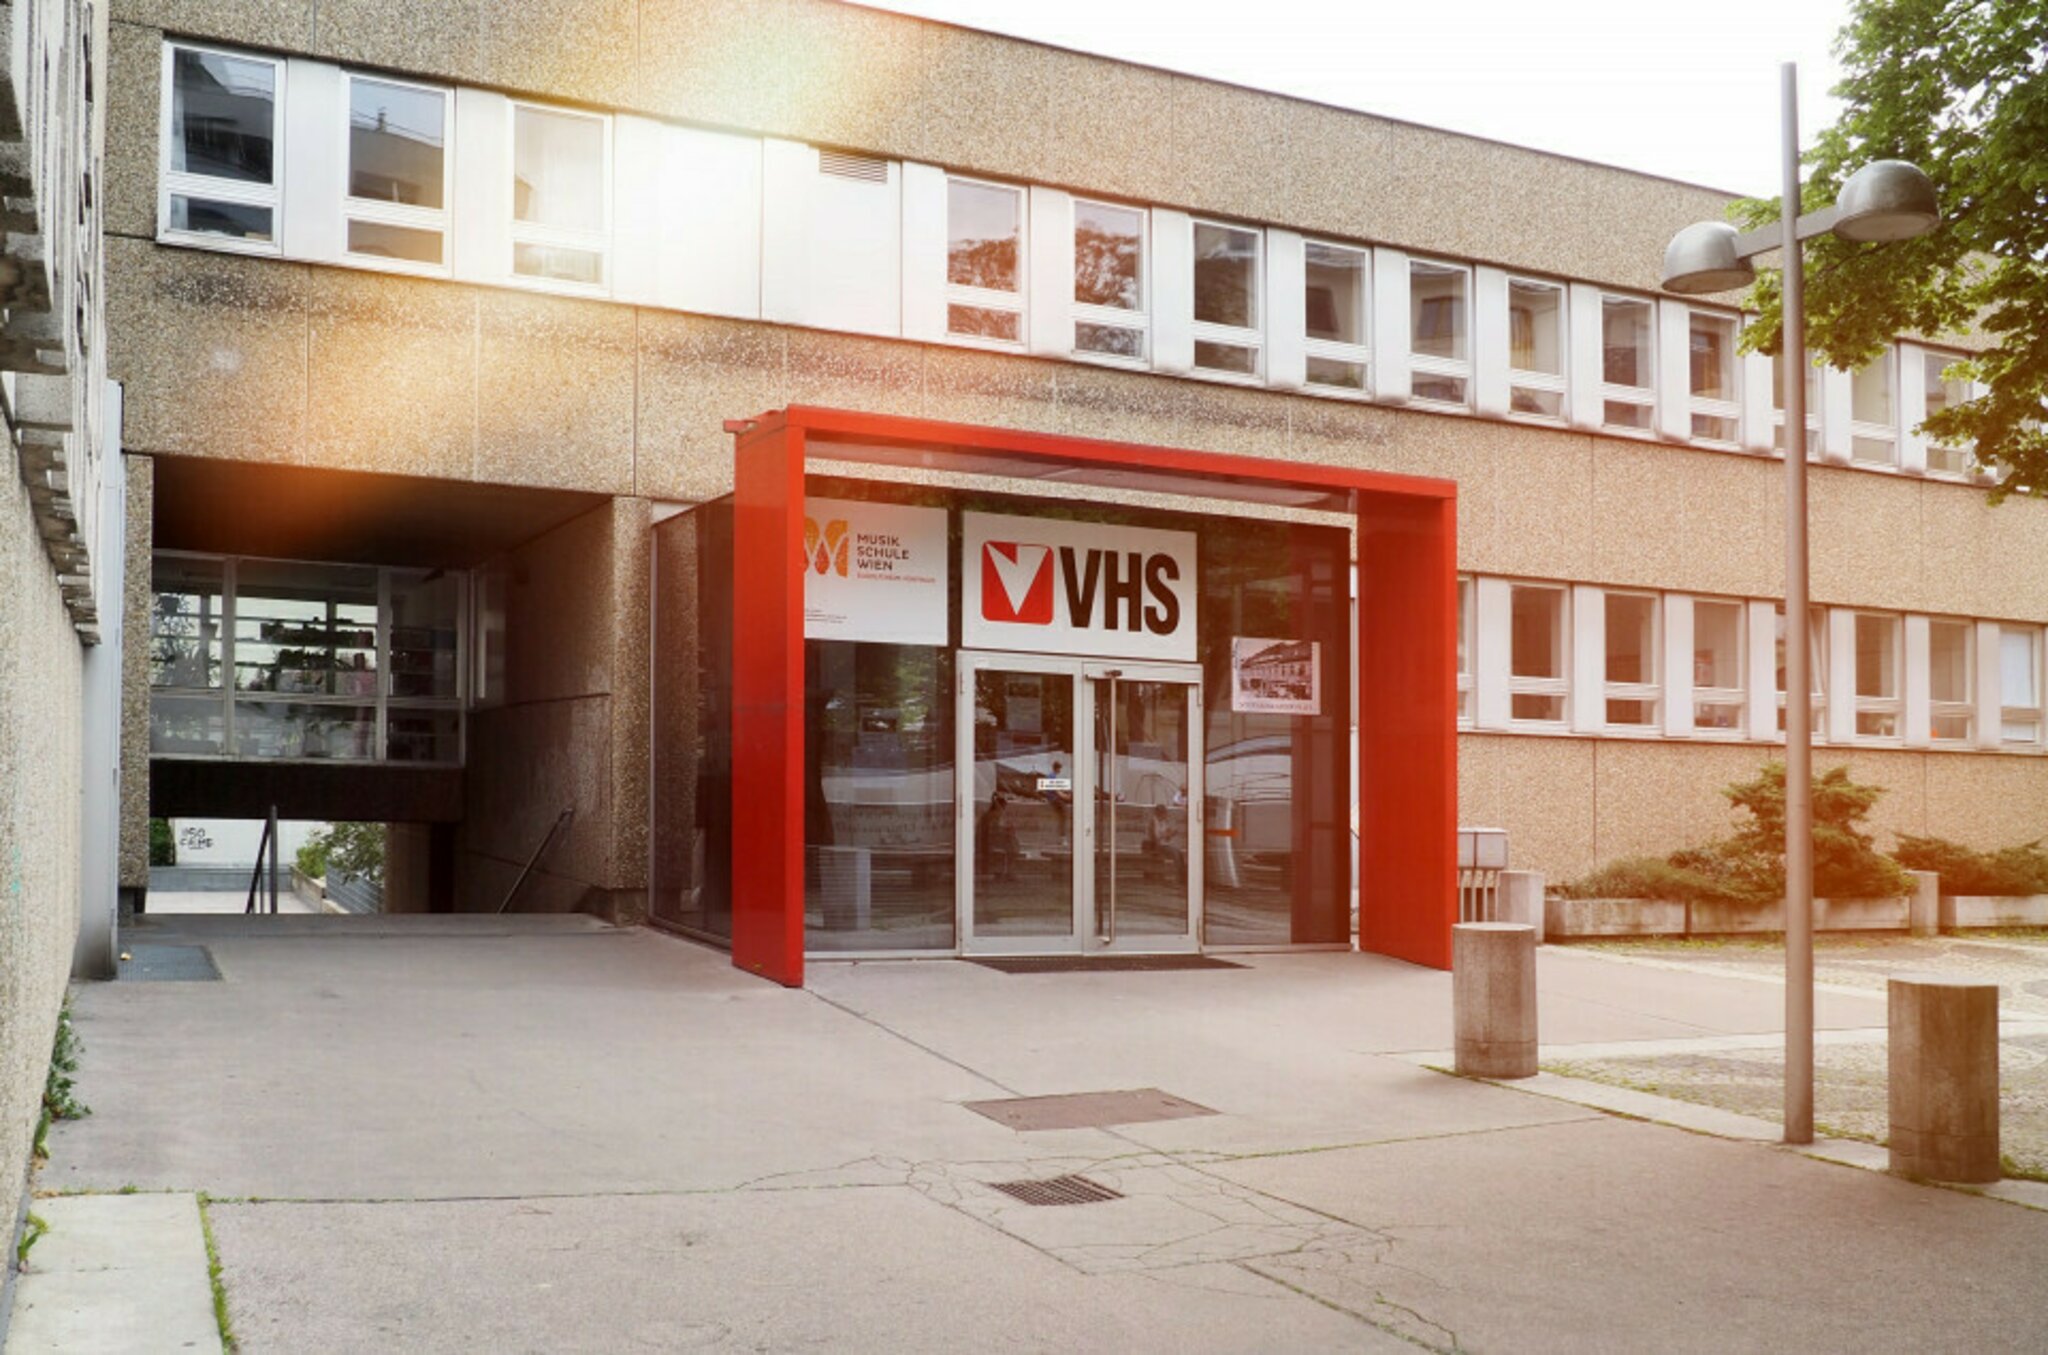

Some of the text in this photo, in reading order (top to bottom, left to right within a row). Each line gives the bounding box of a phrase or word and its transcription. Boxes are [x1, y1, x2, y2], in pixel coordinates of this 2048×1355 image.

[857, 533, 900, 547] MUSIK
[857, 546, 909, 560] SCHULE
[857, 559, 893, 571] WIEN
[1059, 546, 1180, 635] VHS
